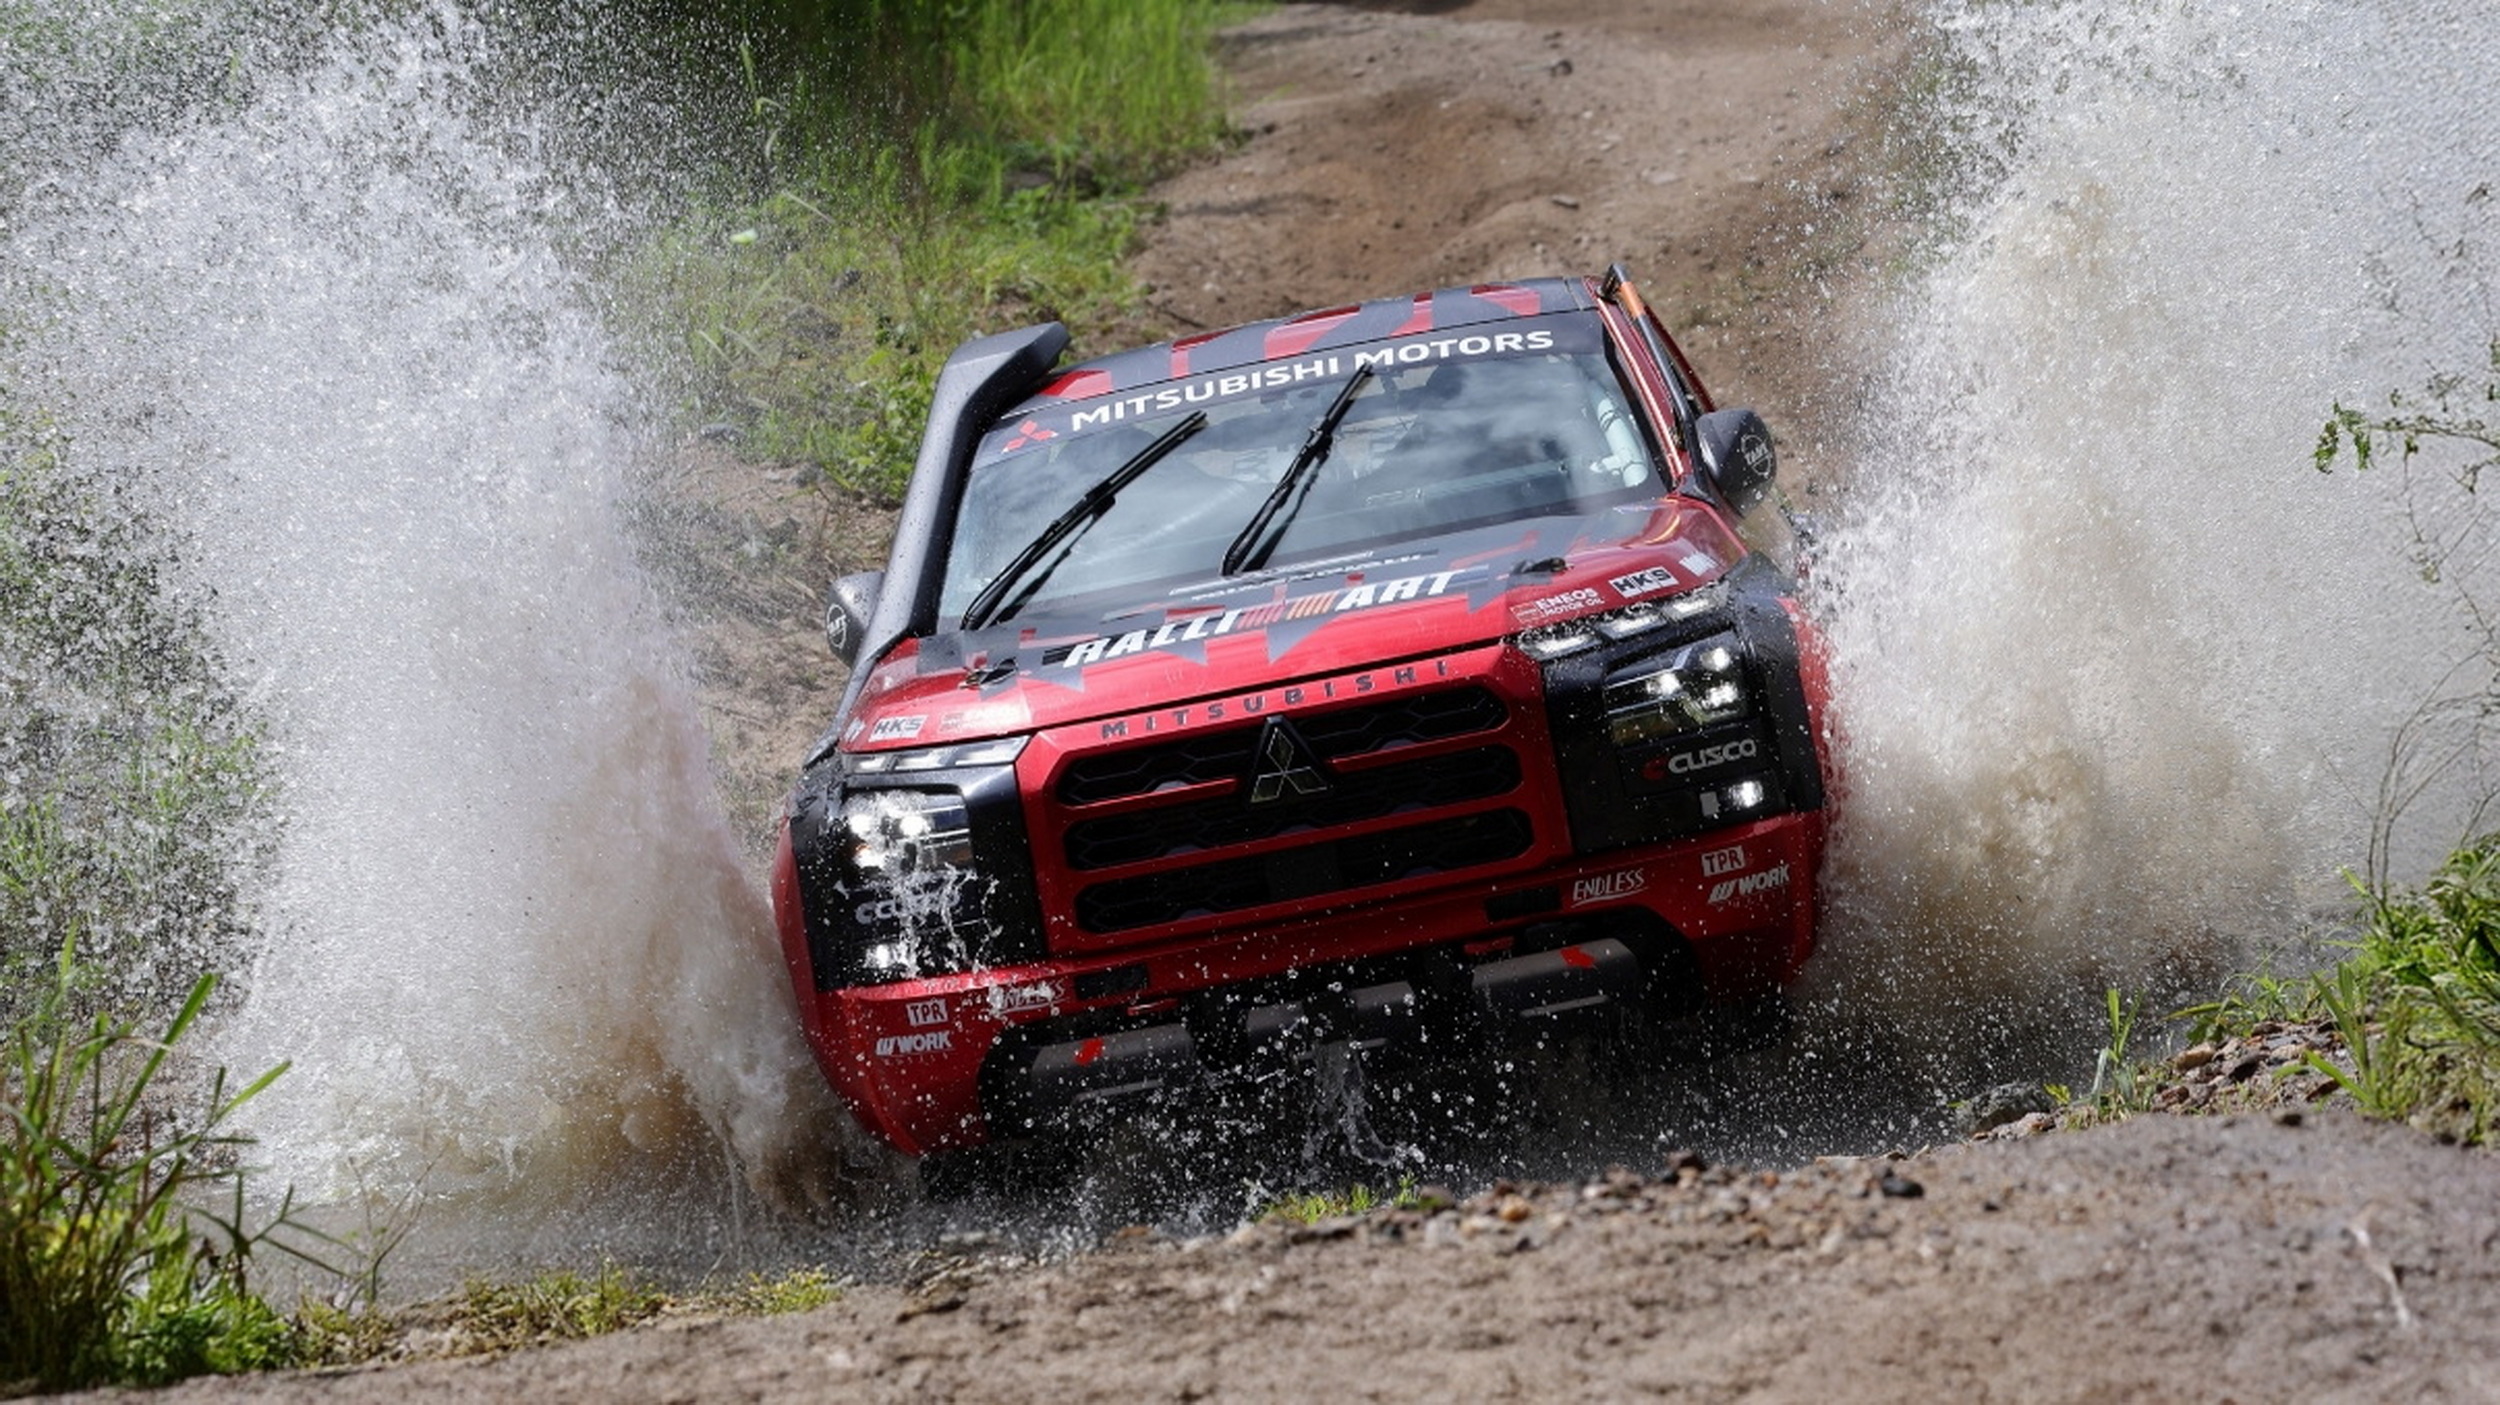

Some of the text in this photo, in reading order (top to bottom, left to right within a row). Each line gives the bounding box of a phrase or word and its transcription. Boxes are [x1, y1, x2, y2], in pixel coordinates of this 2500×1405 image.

[1072, 331, 1554, 431] MITSUBISHI MOTORS
[1611, 567, 1675, 595] HKS
[1536, 588, 1598, 610] ENEOS
[1544, 601, 1584, 617] MOTOR
[1062, 609, 1244, 668] RALLI
[1335, 569, 1466, 611] ART
[1102, 661, 1448, 739] MITSUBISHI
[872, 716, 924, 737] HKS
[1668, 739, 1756, 773] CUSCO
[1704, 849, 1741, 873] TPR
[1573, 867, 1645, 901] ENDLESS
[1738, 864, 1790, 896] WORK
[909, 1002, 946, 1023] TPR
[898, 1031, 952, 1052] WORK
